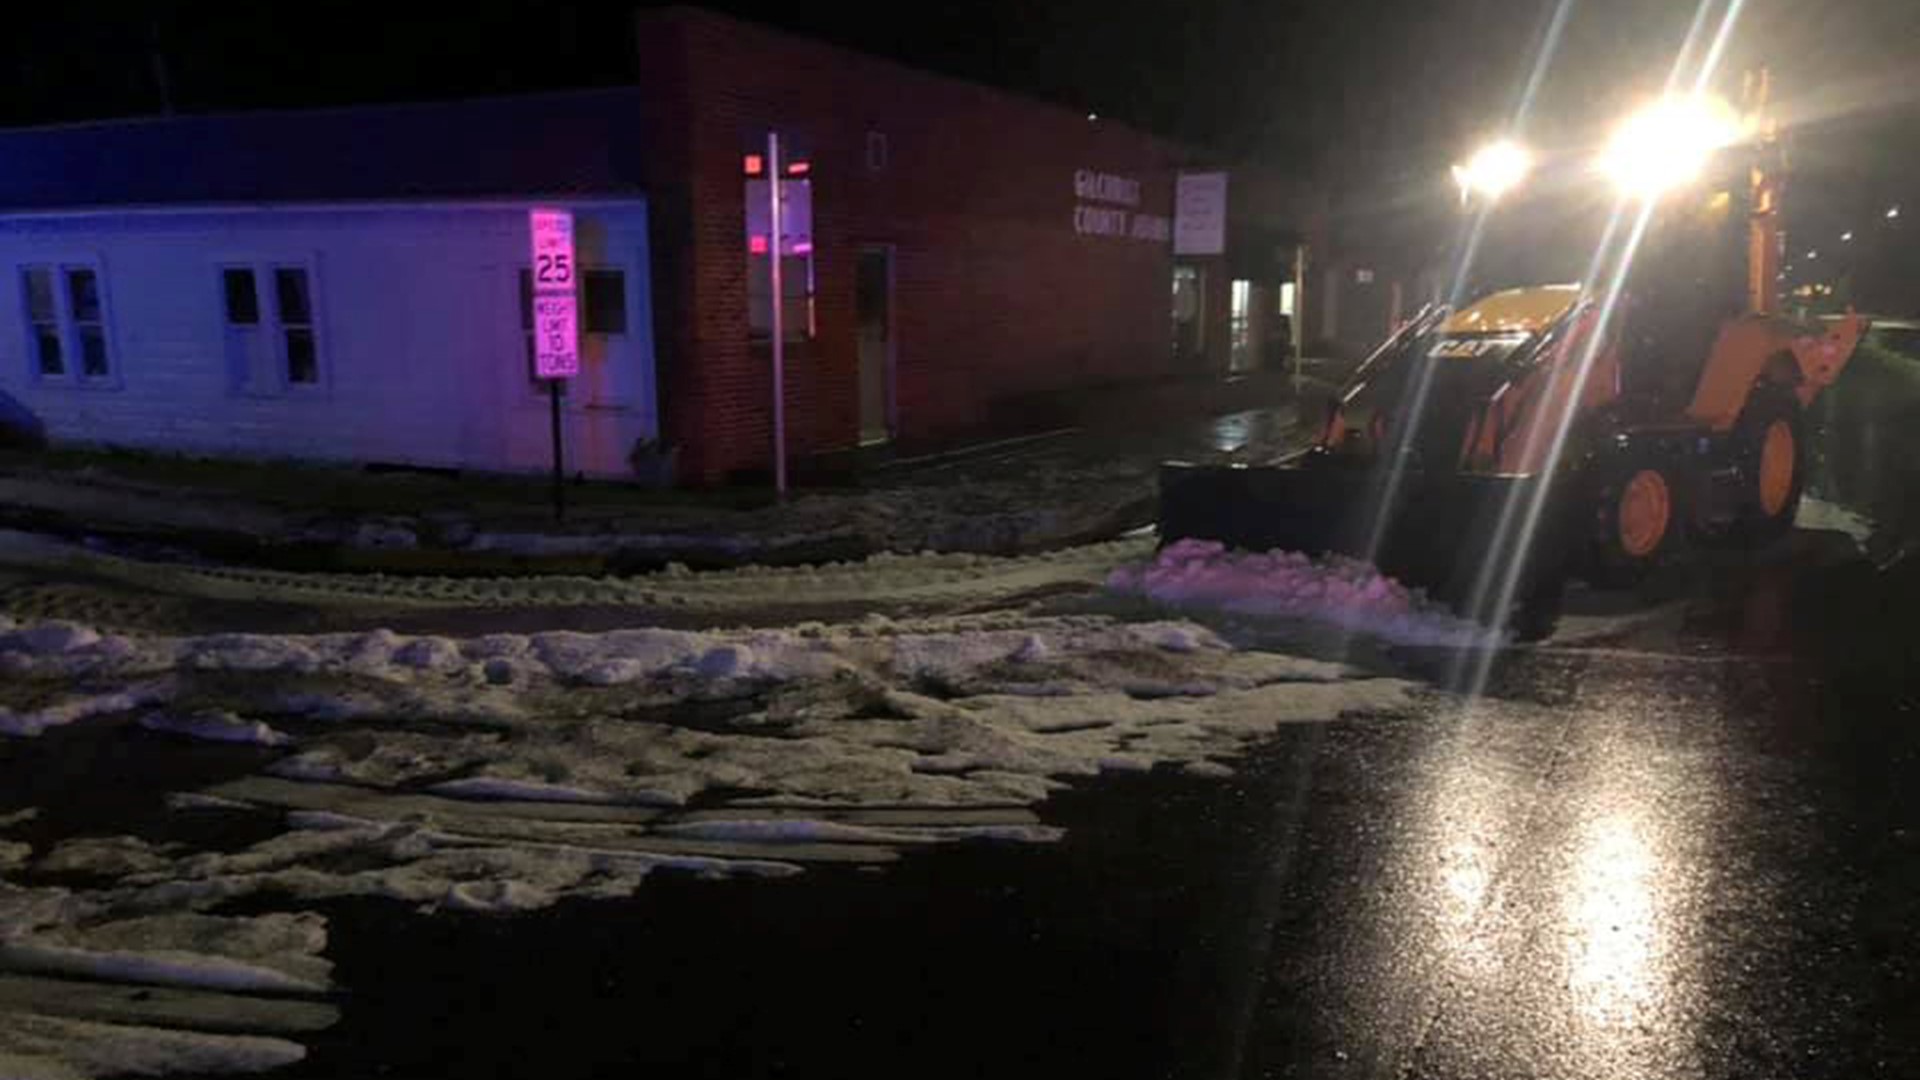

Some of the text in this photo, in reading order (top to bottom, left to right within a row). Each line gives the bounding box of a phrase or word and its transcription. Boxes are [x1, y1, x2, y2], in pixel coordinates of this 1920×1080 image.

[538, 254, 570, 282] 25
[542, 317, 568, 333] LIMIT
[549, 333, 564, 352] 10
[539, 352, 575, 371] TONS
